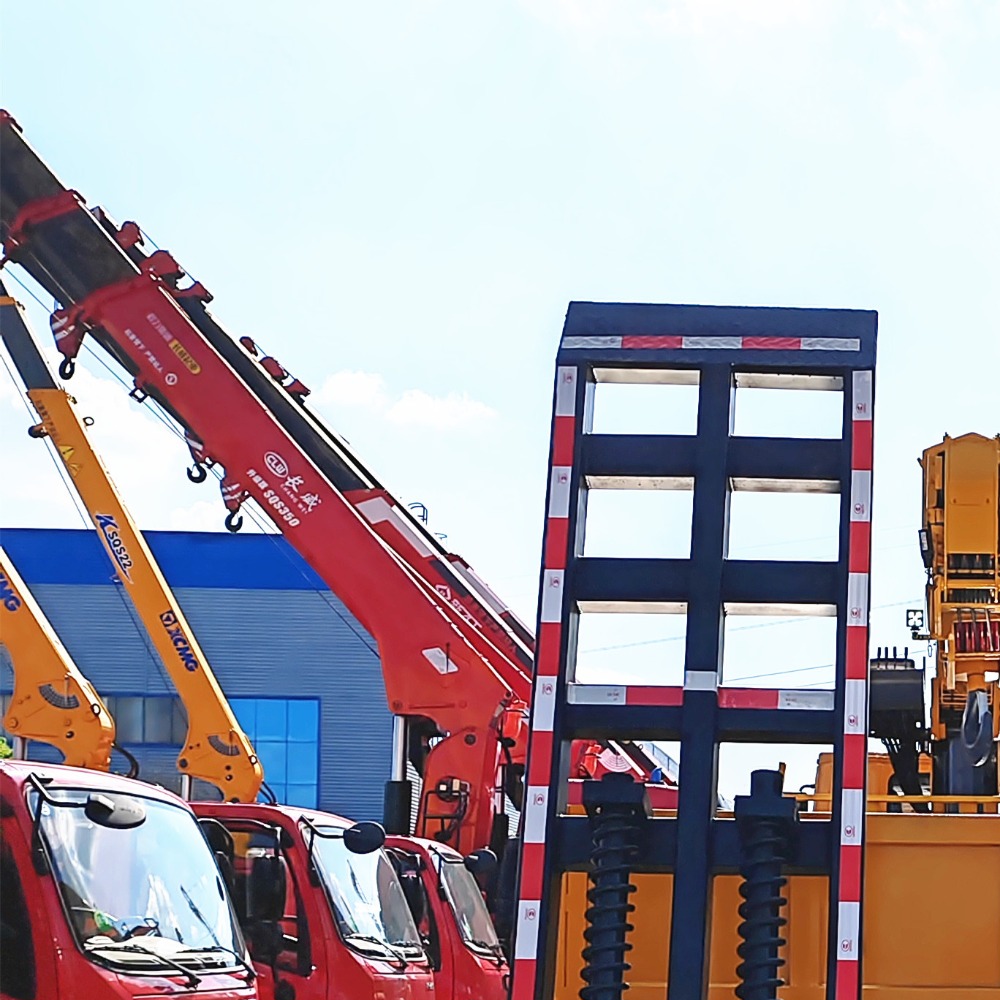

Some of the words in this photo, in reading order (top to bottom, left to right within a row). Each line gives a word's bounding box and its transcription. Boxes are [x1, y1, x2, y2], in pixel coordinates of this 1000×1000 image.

[266, 455, 286, 474] CLW
[263, 490, 300, 526] SQS350
[168, 626, 199, 672] XCMG
